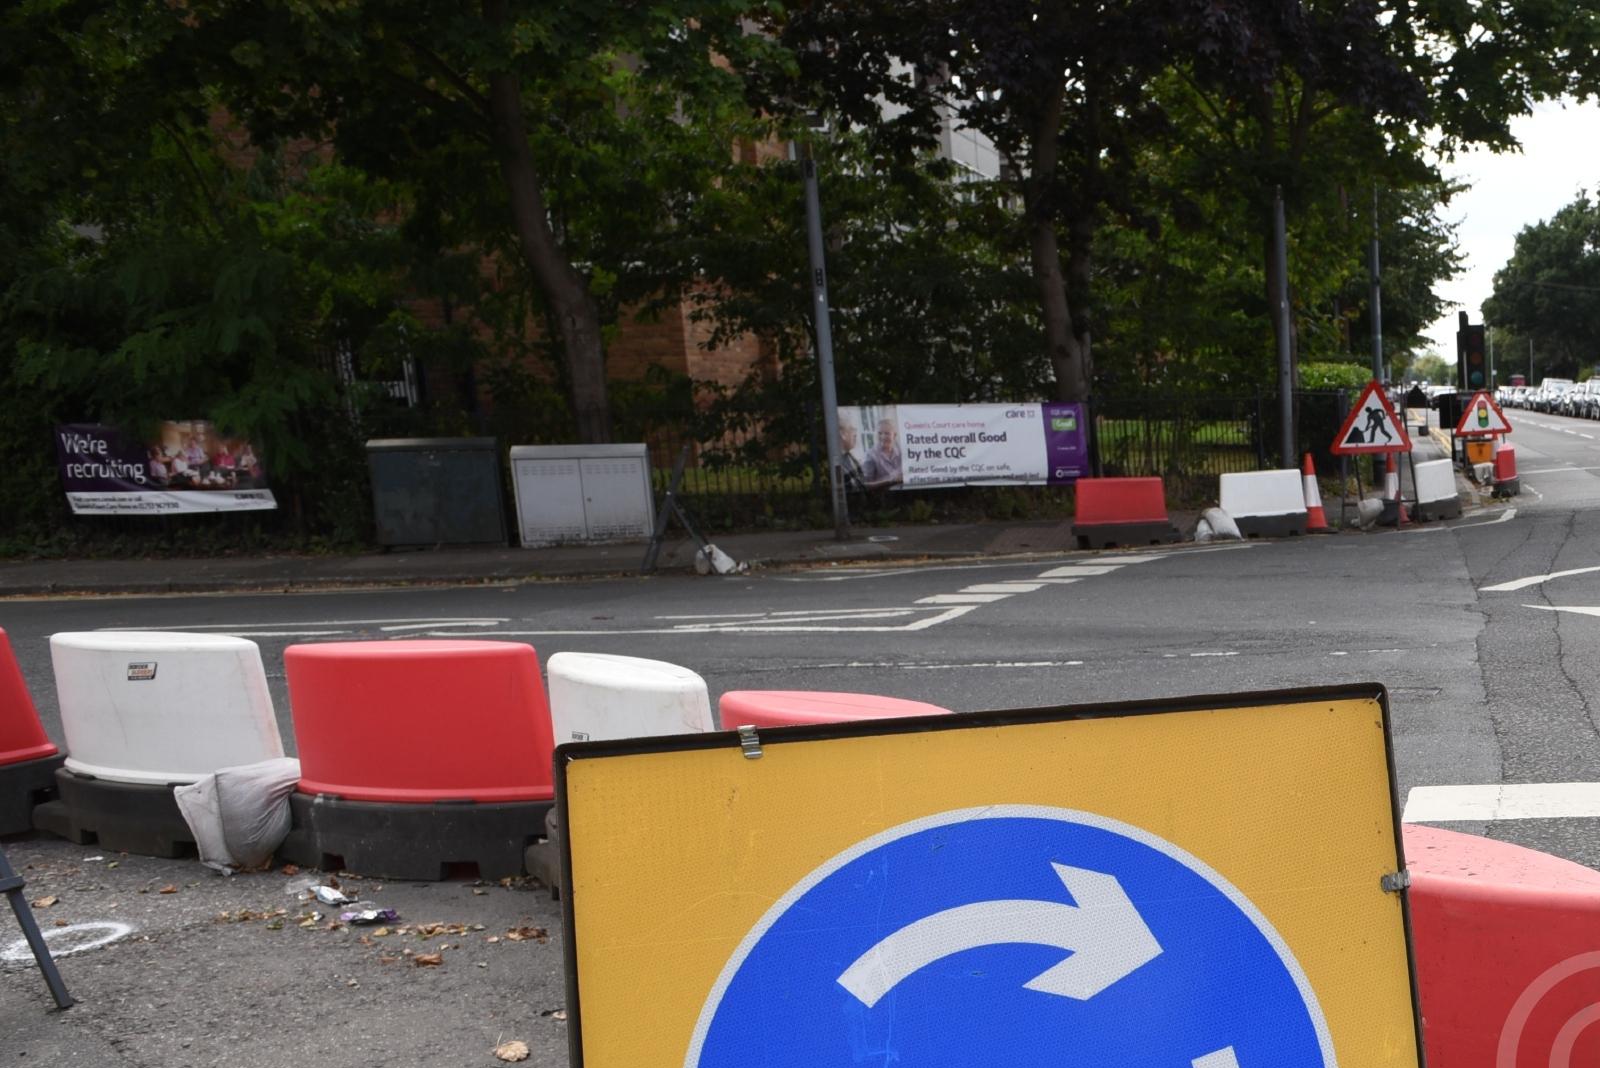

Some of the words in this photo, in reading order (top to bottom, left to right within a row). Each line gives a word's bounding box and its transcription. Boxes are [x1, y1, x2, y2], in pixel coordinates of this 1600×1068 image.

[1005, 410, 1026, 419] care
[60, 432, 107, 454] We're
[906, 433, 939, 445] Rated
[940, 432, 977, 444] overall
[978, 431, 1007, 443] Good
[907, 447, 921, 462] by
[924, 447, 942, 459] the
[944, 446, 966, 458] CQC
[66, 459, 147, 485] recruiting
[908, 465, 929, 474] Rated
[930, 465, 948, 473] Good
[949, 465, 958, 474] by
[958, 464, 970, 472] the
